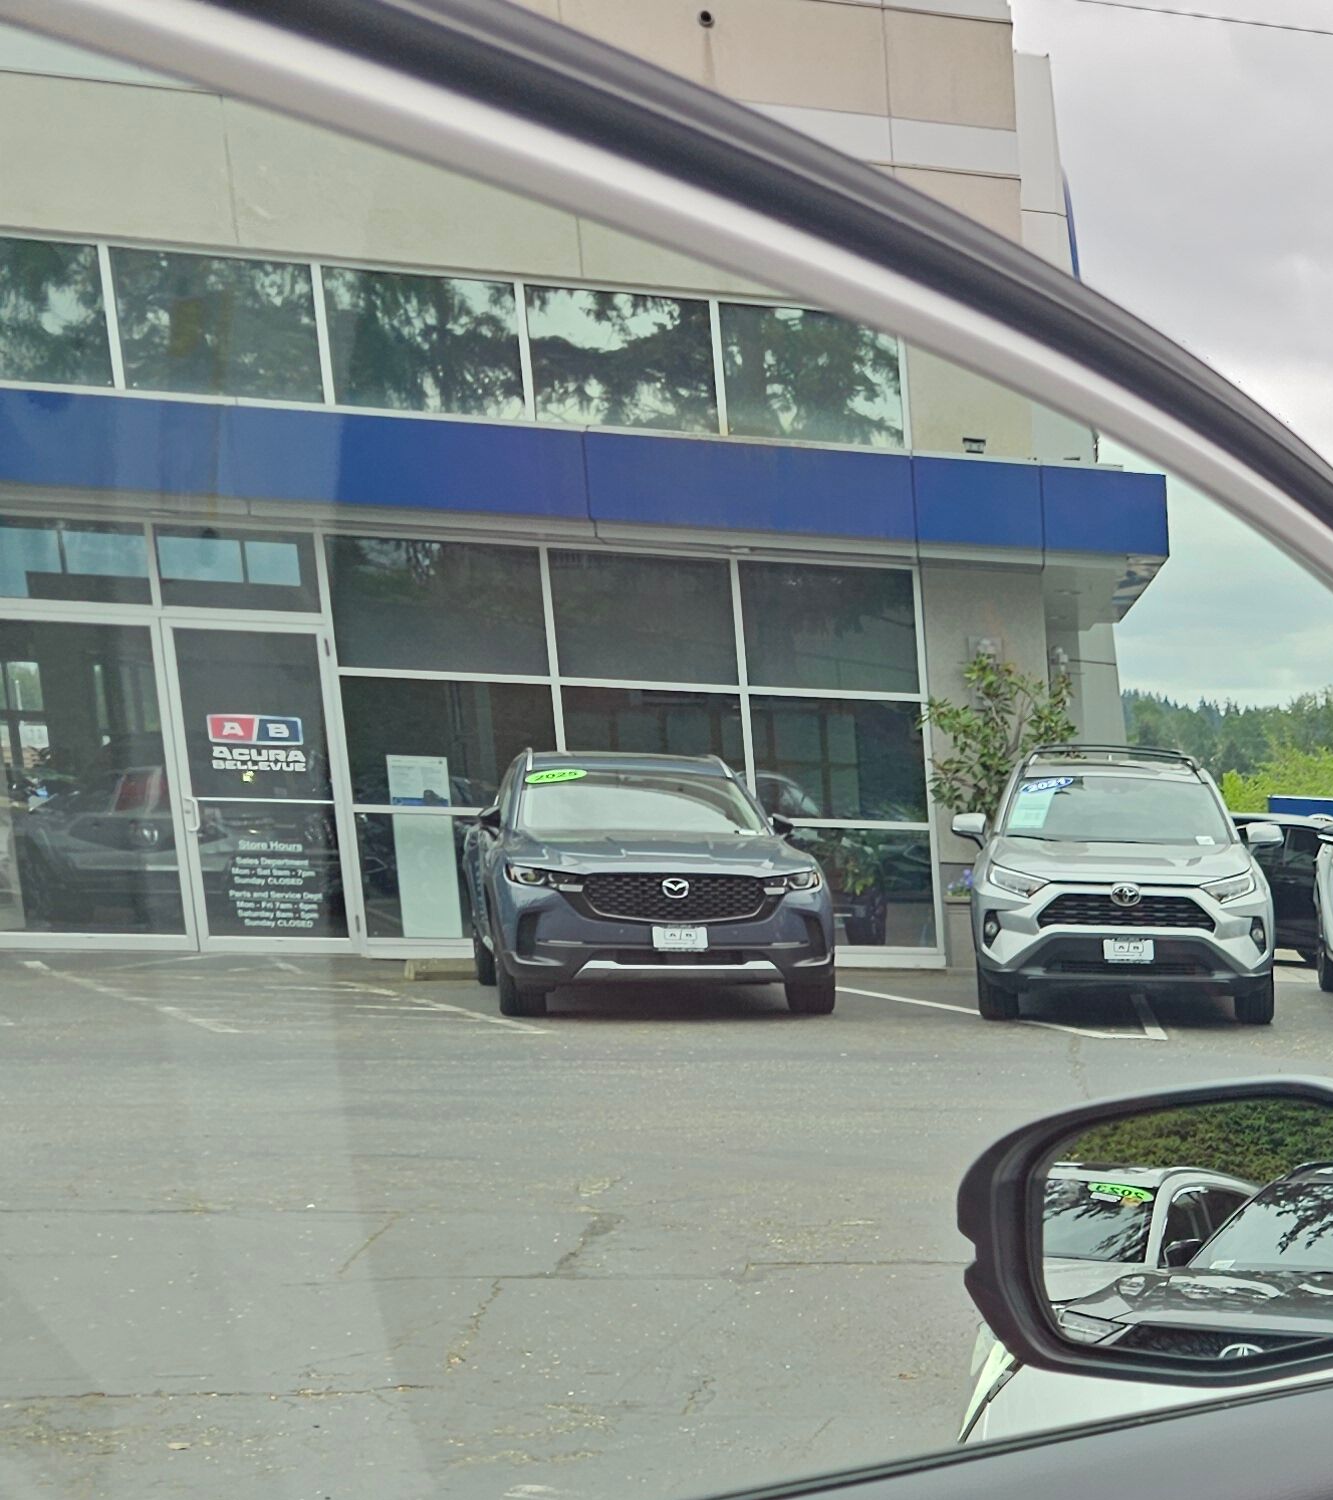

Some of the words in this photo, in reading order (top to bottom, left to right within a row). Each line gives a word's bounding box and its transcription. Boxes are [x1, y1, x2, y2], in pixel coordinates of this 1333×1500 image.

[222, 721, 245, 736] A
[266, 723, 290, 738] B
[212, 746, 306, 762] ACURA
[212, 759, 307, 772] BELLEVUE
[238, 839, 268, 851] Store
[269, 840, 303, 853] Hours
[235, 856, 259, 865] Sales
[260, 857, 309, 868] Department
[234, 876, 266, 887] Sunday
[267, 877, 304, 886] CLOSED
[244, 918, 275, 928] Sunday
[277, 920, 314, 928] CLOSED
